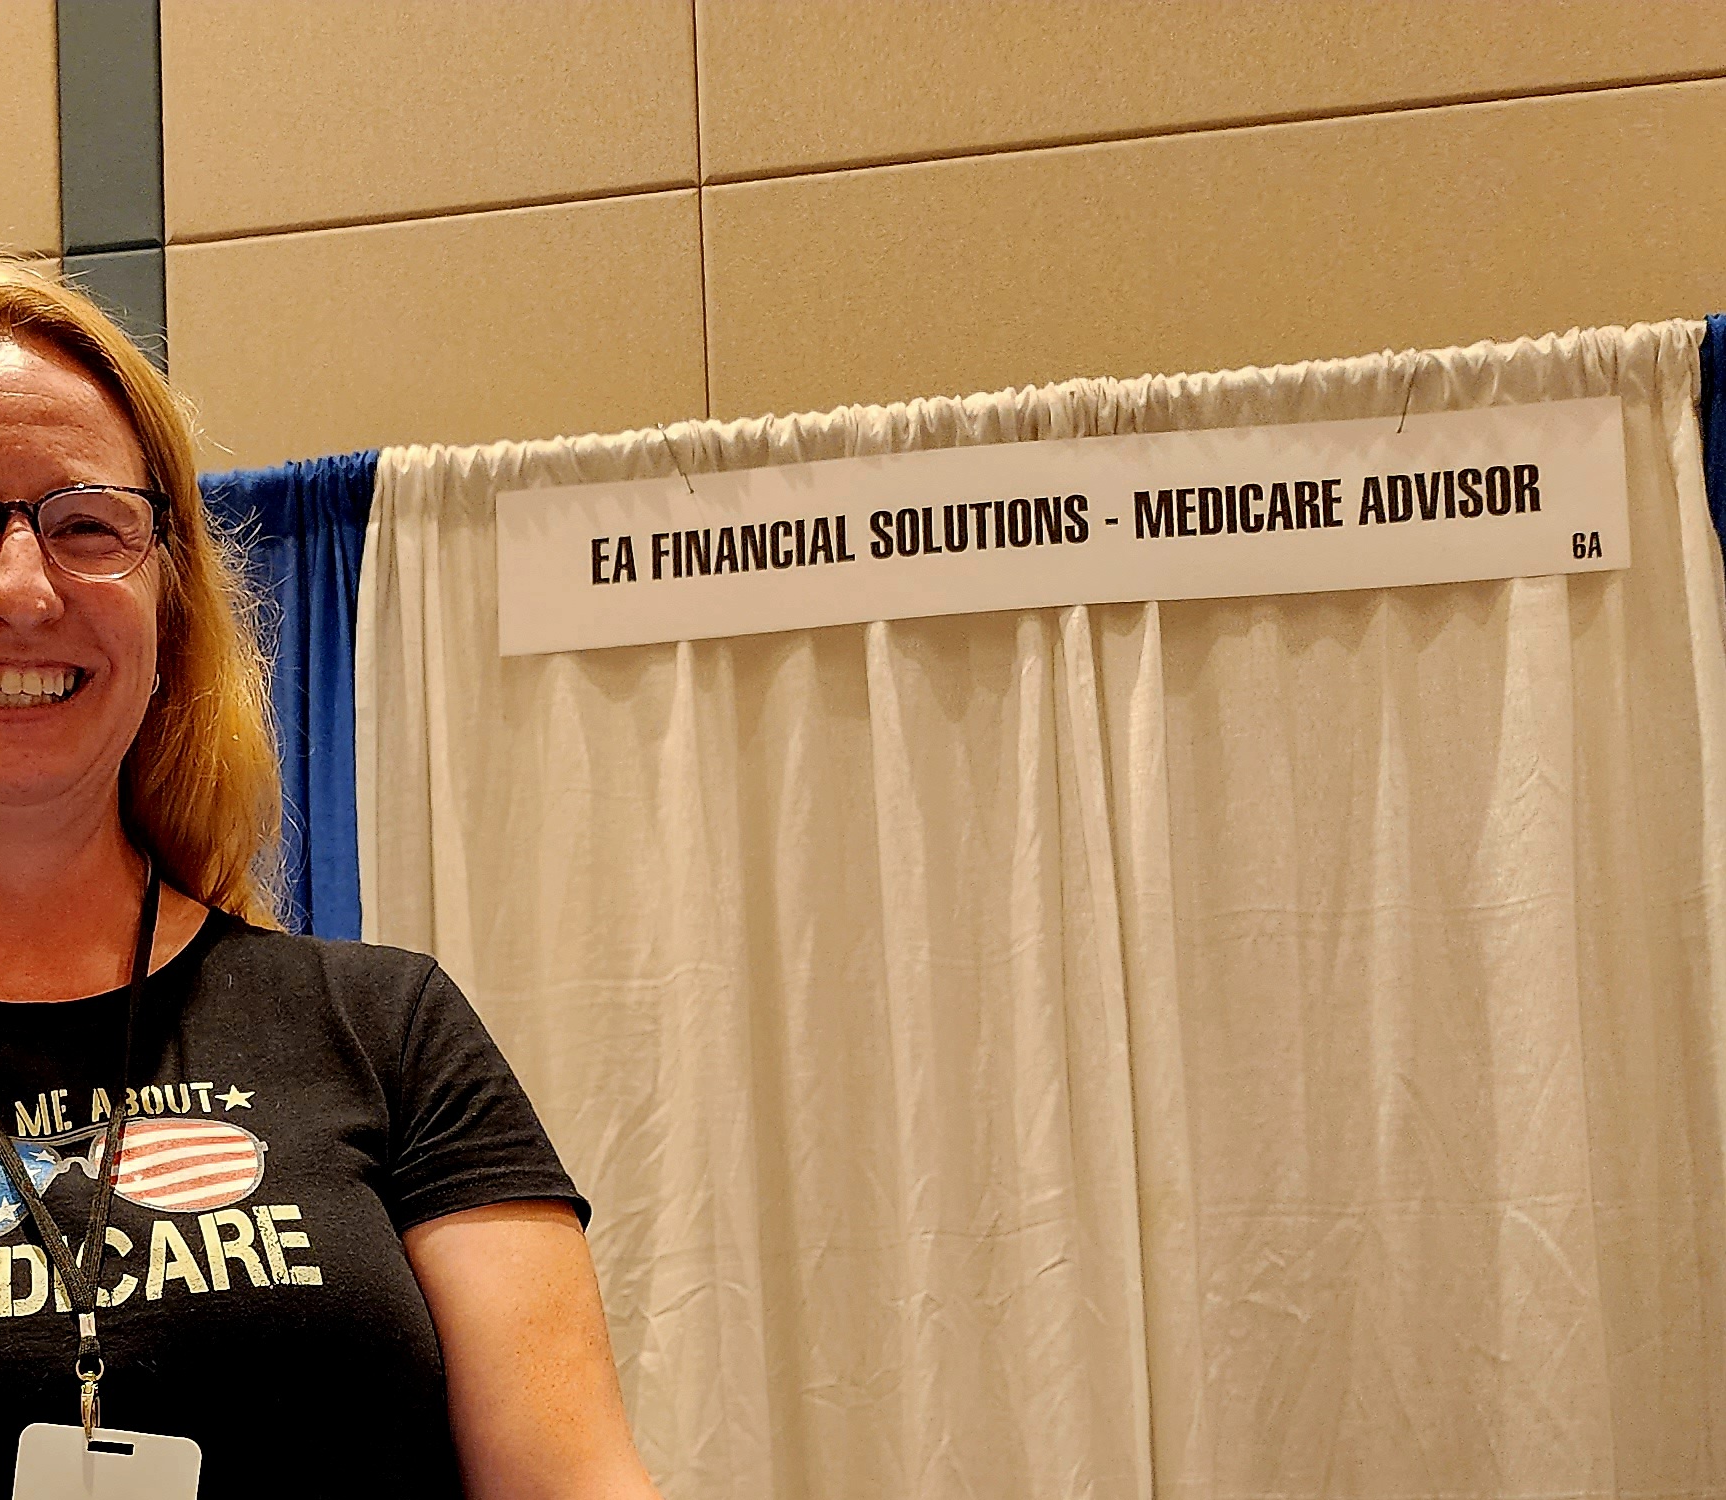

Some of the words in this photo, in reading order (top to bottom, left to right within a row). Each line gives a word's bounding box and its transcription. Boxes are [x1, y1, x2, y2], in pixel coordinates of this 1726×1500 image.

[590, 536, 638, 585] EA
[652, 514, 856, 580] FINANCIAL
[870, 493, 1091, 560] SOLUTIONS
[1132, 477, 1345, 540] MEDICARE
[1358, 463, 1543, 527] ADVISOR
[1570, 531, 1603, 561] 6A
[14, 1088, 73, 1138] ME
